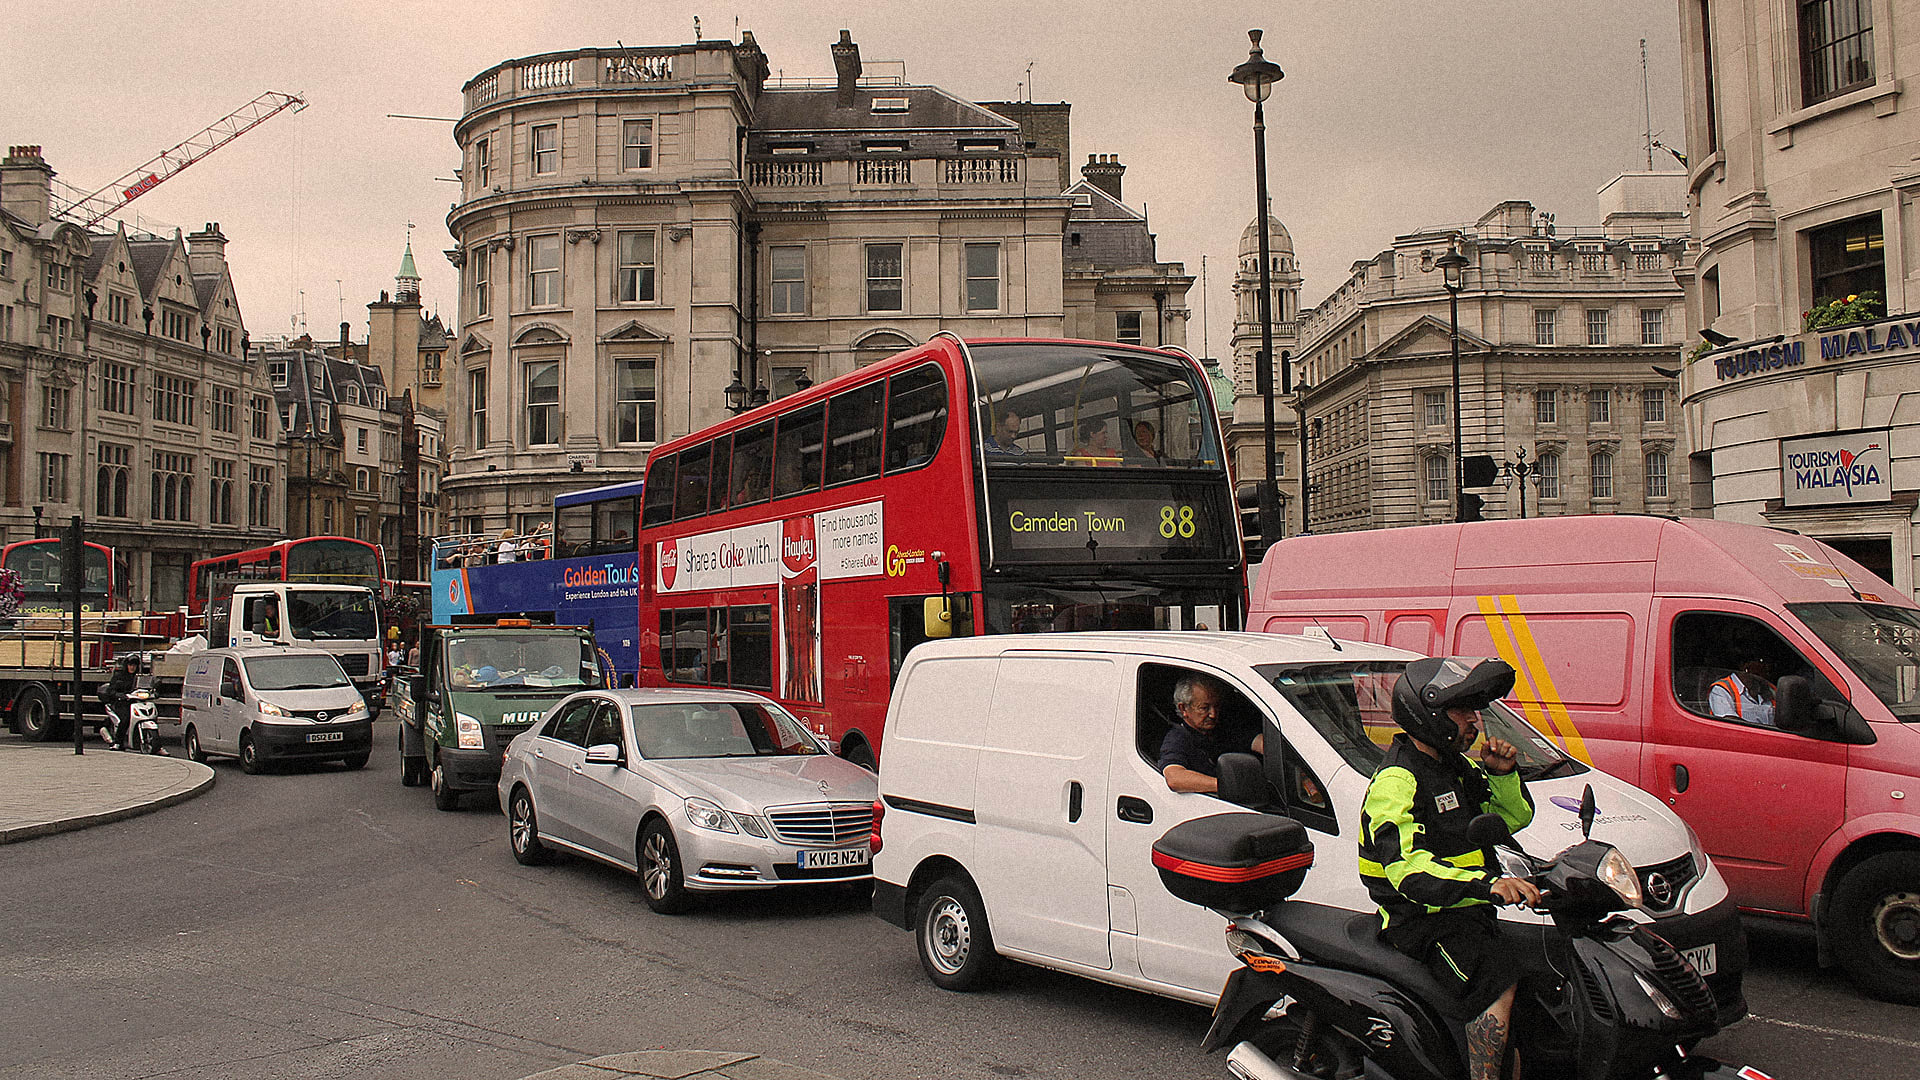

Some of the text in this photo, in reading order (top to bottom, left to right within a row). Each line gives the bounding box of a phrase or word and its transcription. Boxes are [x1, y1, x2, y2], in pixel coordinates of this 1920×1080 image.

[1714, 341, 1804, 380] TOURISM
[1788, 450, 1840, 469] TOURISM
[1796, 463, 1881, 497] MALAYSIA
[822, 509, 878, 533] Find thousands
[1010, 505, 1196, 539] Camden Town 88
[784, 535, 814, 561] Hayley
[832, 531, 878, 551] more names
[686, 549, 709, 573] Share
[711, 551, 717, 570] a
[720, 543, 744, 569] Coke
[565, 587, 638, 602] Experience London and the UK
[809, 850, 864, 867] KV13 NZW
